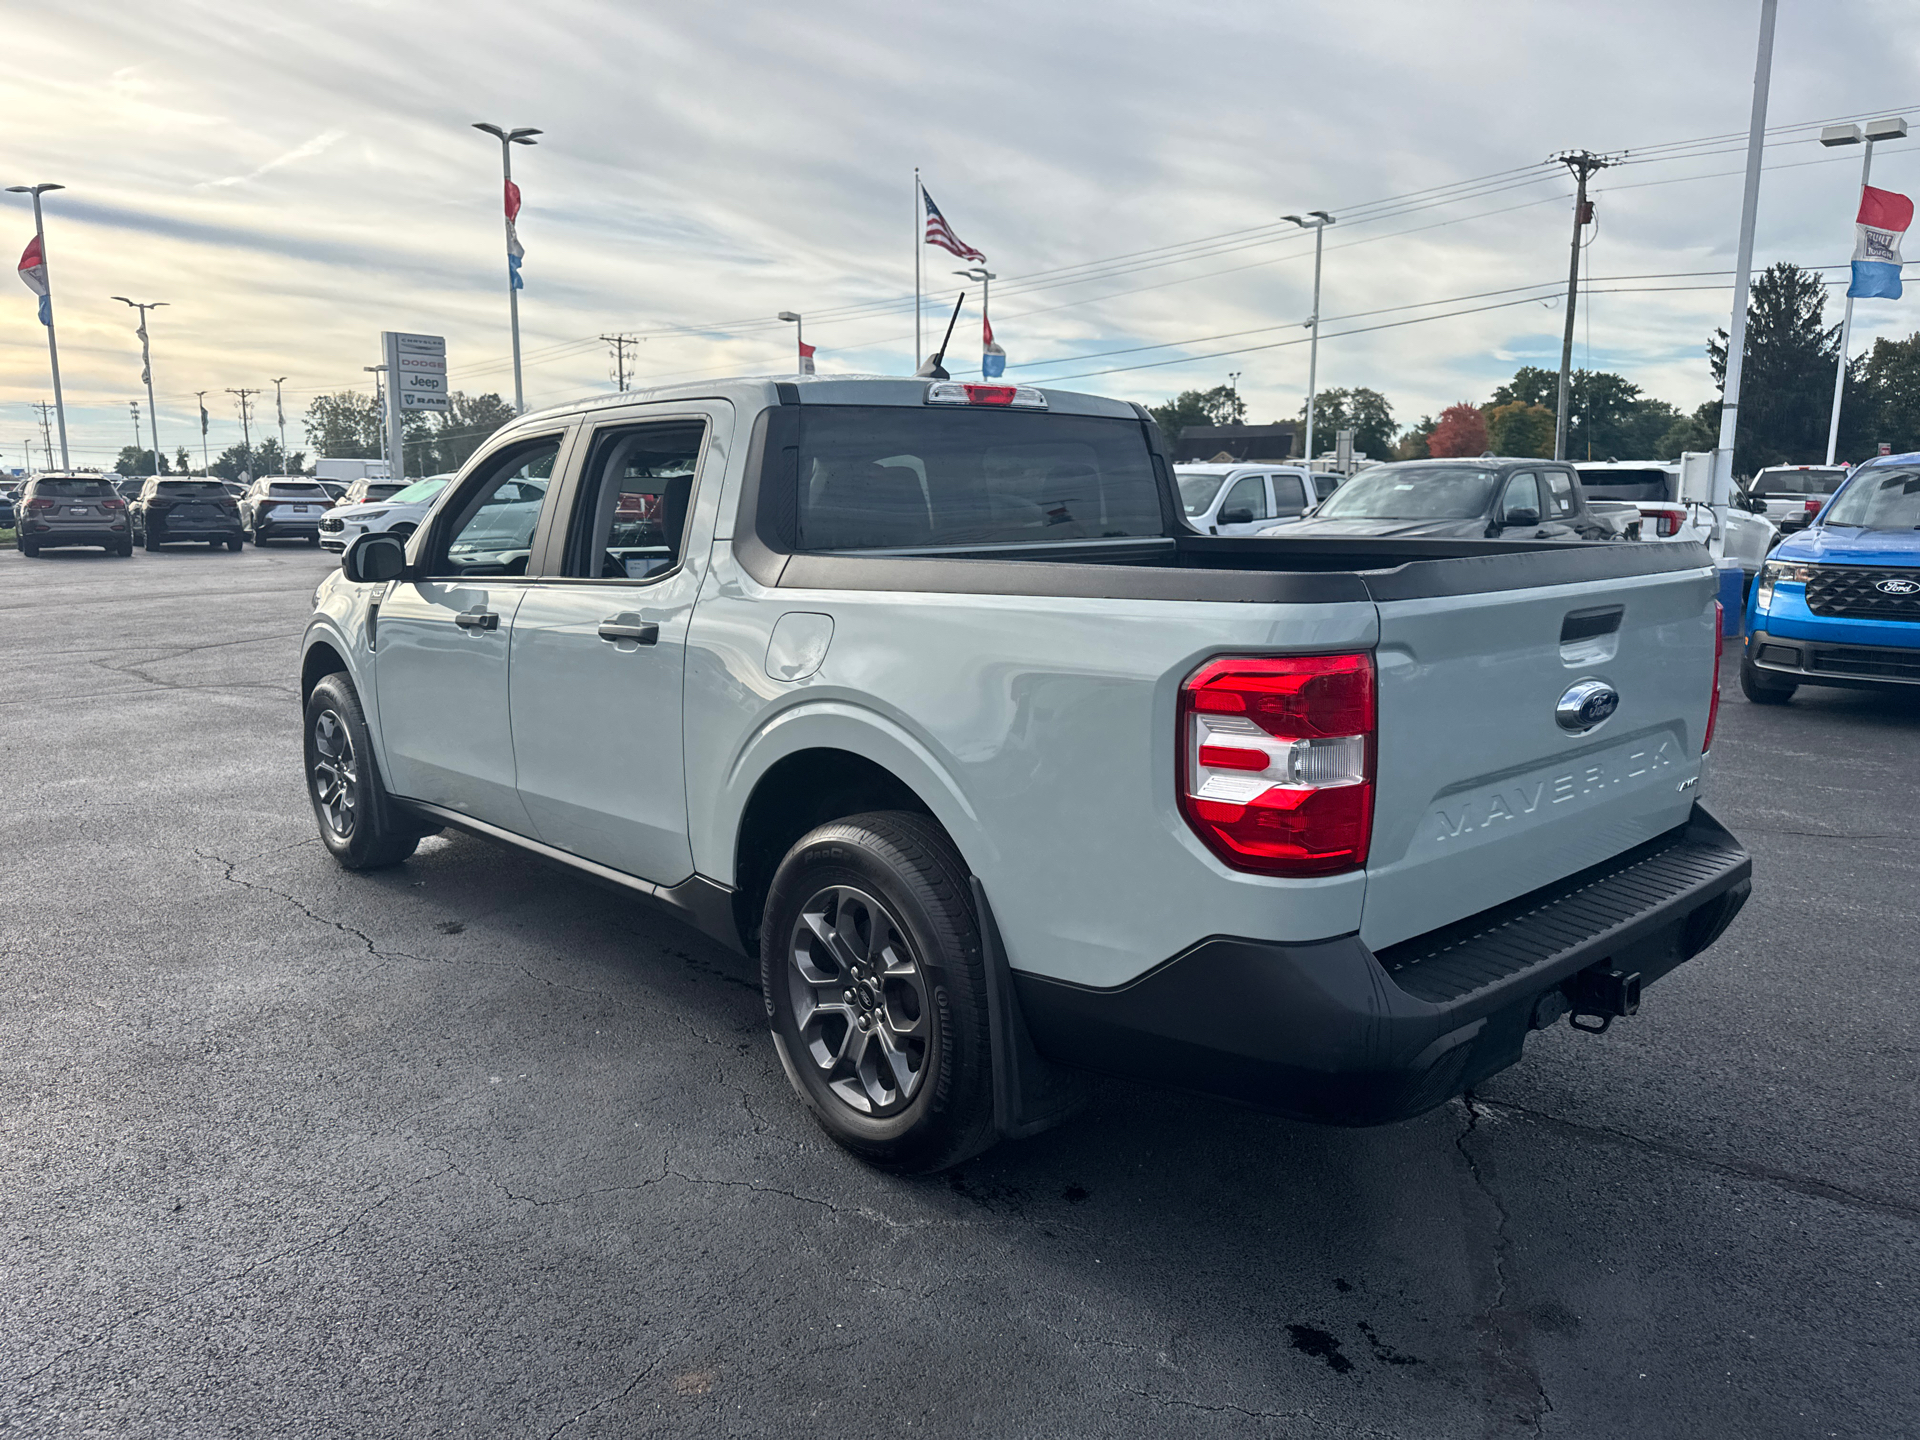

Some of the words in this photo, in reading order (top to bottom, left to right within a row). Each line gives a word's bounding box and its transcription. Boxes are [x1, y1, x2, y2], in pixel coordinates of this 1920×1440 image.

[1867, 247, 1892, 260] TOUGH
[401, 338, 443, 346] CHRYSLER
[402, 359, 445, 368] DODGE
[410, 375, 439, 389] Jeep
[417, 397, 447, 405] RAM
[1884, 582, 1912, 592] Ford
